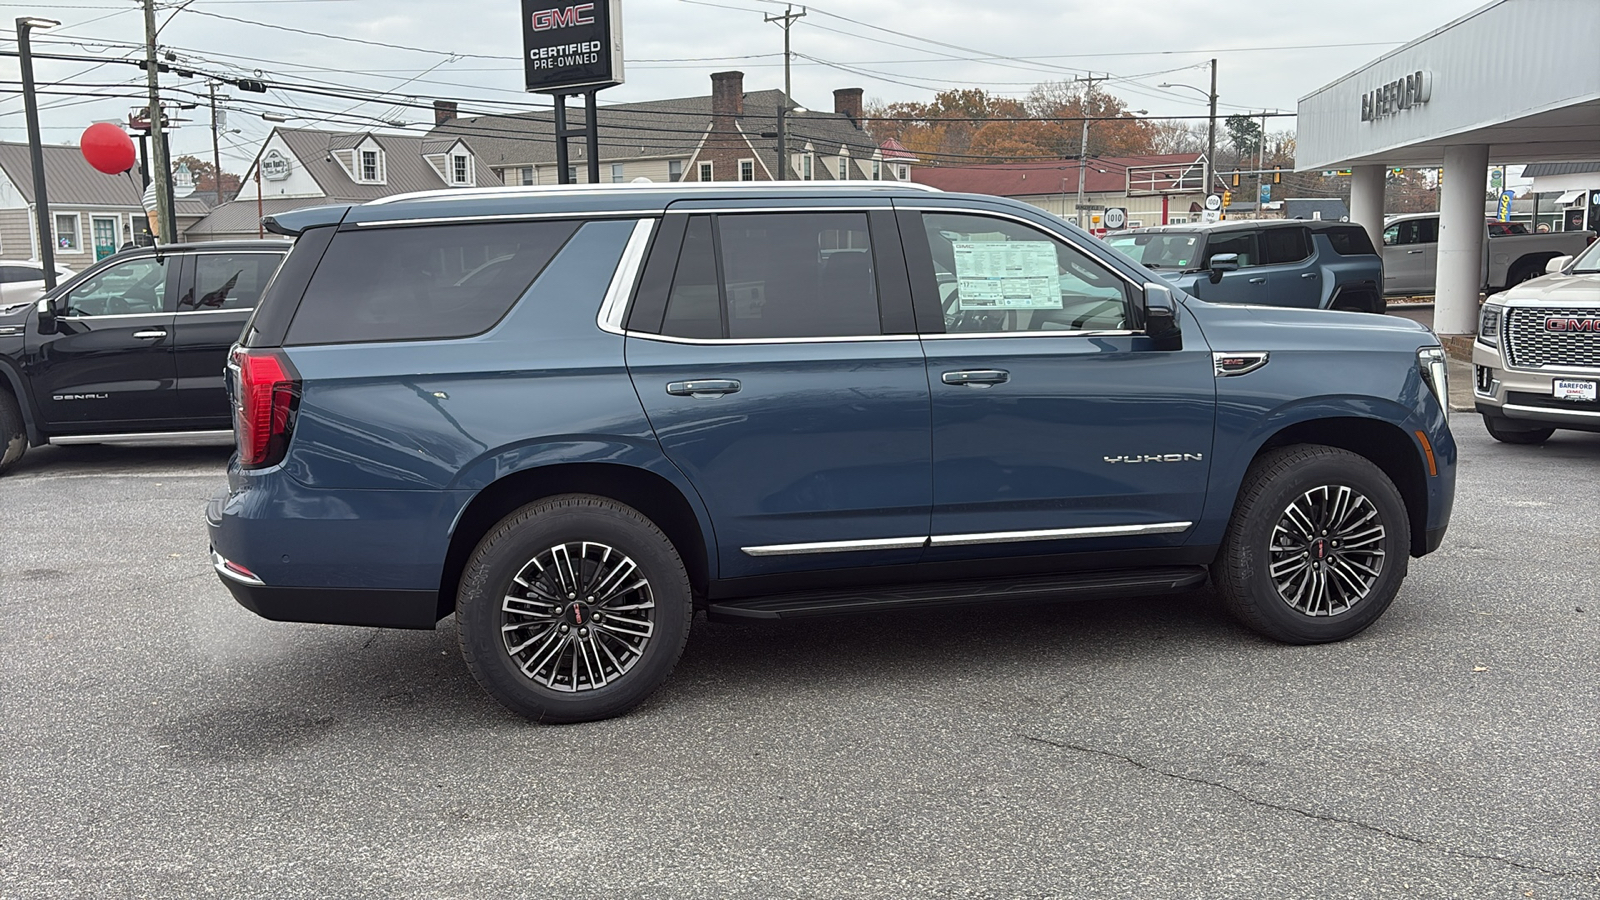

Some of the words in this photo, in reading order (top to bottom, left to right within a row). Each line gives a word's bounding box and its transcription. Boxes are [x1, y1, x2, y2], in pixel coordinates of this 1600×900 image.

[532, 3, 595, 31] GMC
[530, 41, 601, 59] CERTIFIED
[534, 53, 598, 70] PRE-OWNED
[1361, 71, 1430, 122] BAREFORD
[1107, 213, 1123, 222] 1010
[1546, 319, 1600, 332] GM
[1559, 382, 1593, 390] BAREFORD
[1103, 453, 1203, 464] YUKON
